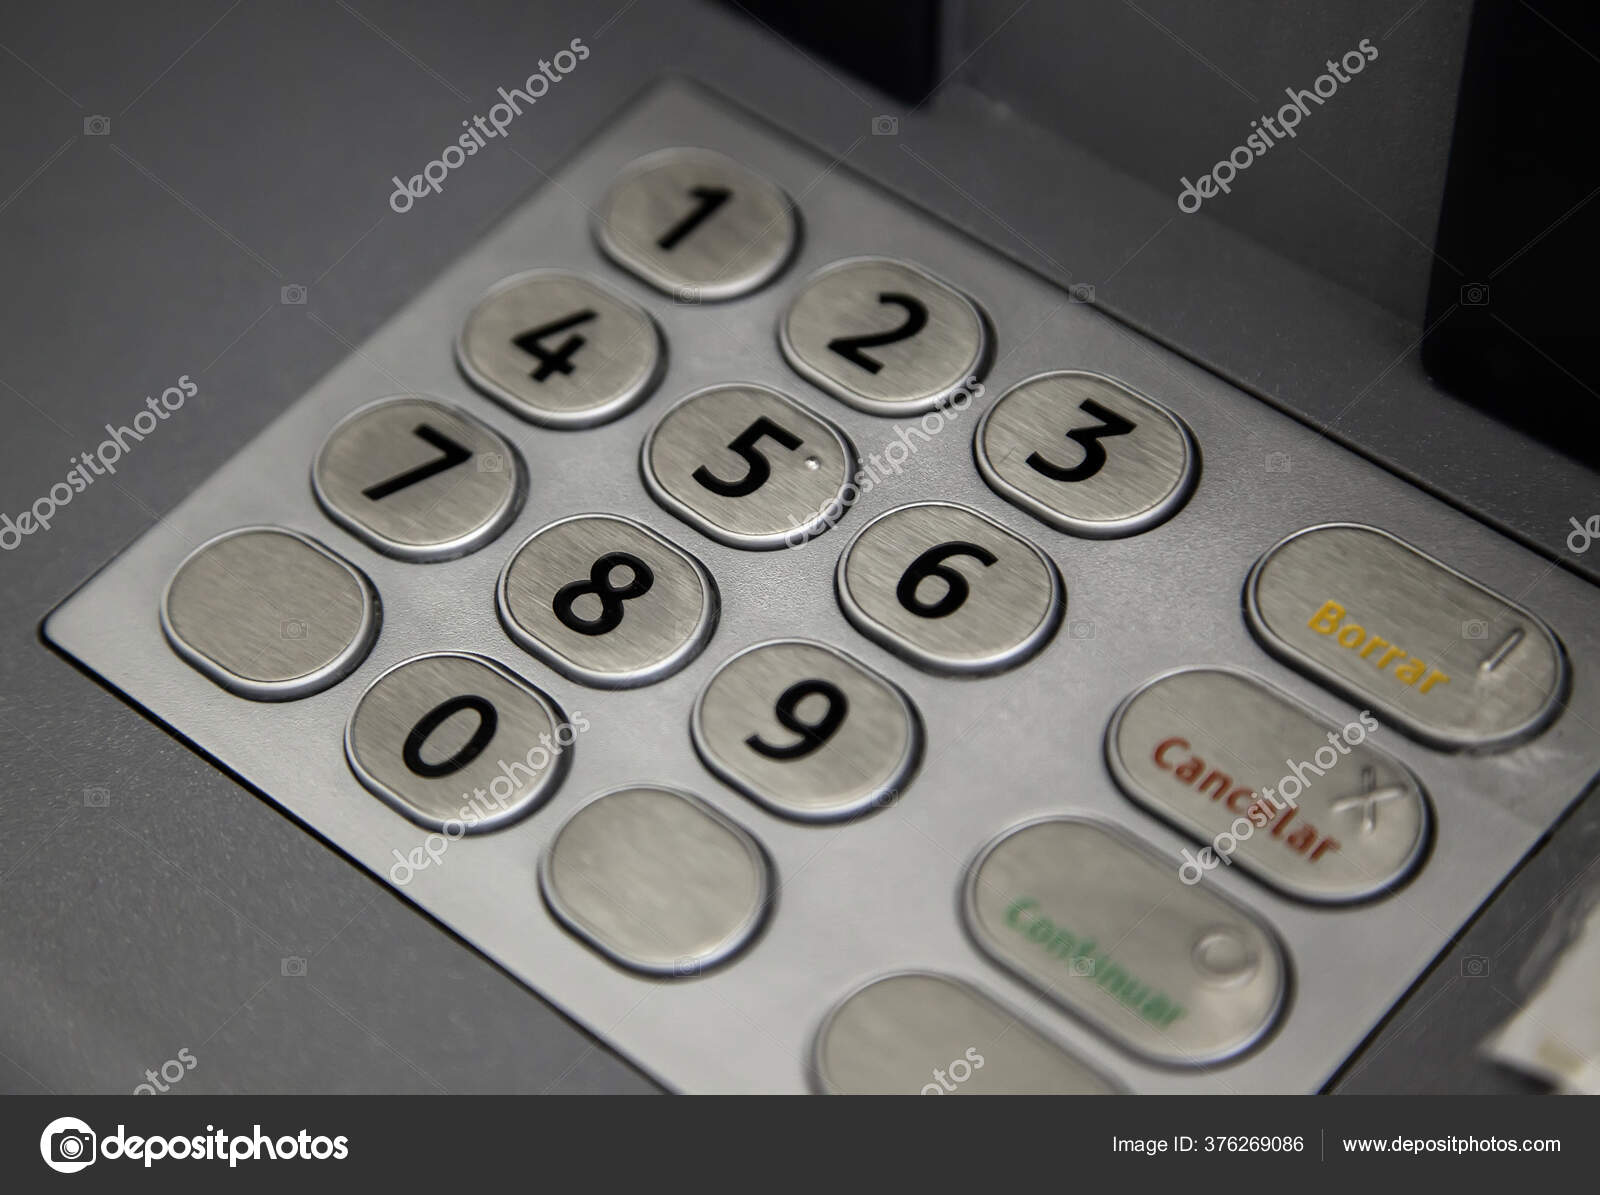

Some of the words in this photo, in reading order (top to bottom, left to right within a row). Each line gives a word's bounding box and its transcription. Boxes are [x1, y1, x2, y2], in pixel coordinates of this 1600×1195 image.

[655, 184, 735, 252] 1
[512, 309, 599, 383] 4
[827, 293, 930, 375] 2
[362, 423, 474, 501] 7
[692, 416, 804, 498] 5
[1025, 398, 1138, 482] 3
[552, 551, 655, 637] 8
[896, 541, 999, 620] 6
[1307, 599, 1450, 695] Borrar
[402, 694, 499, 780] 0
[745, 679, 849, 762] 9
